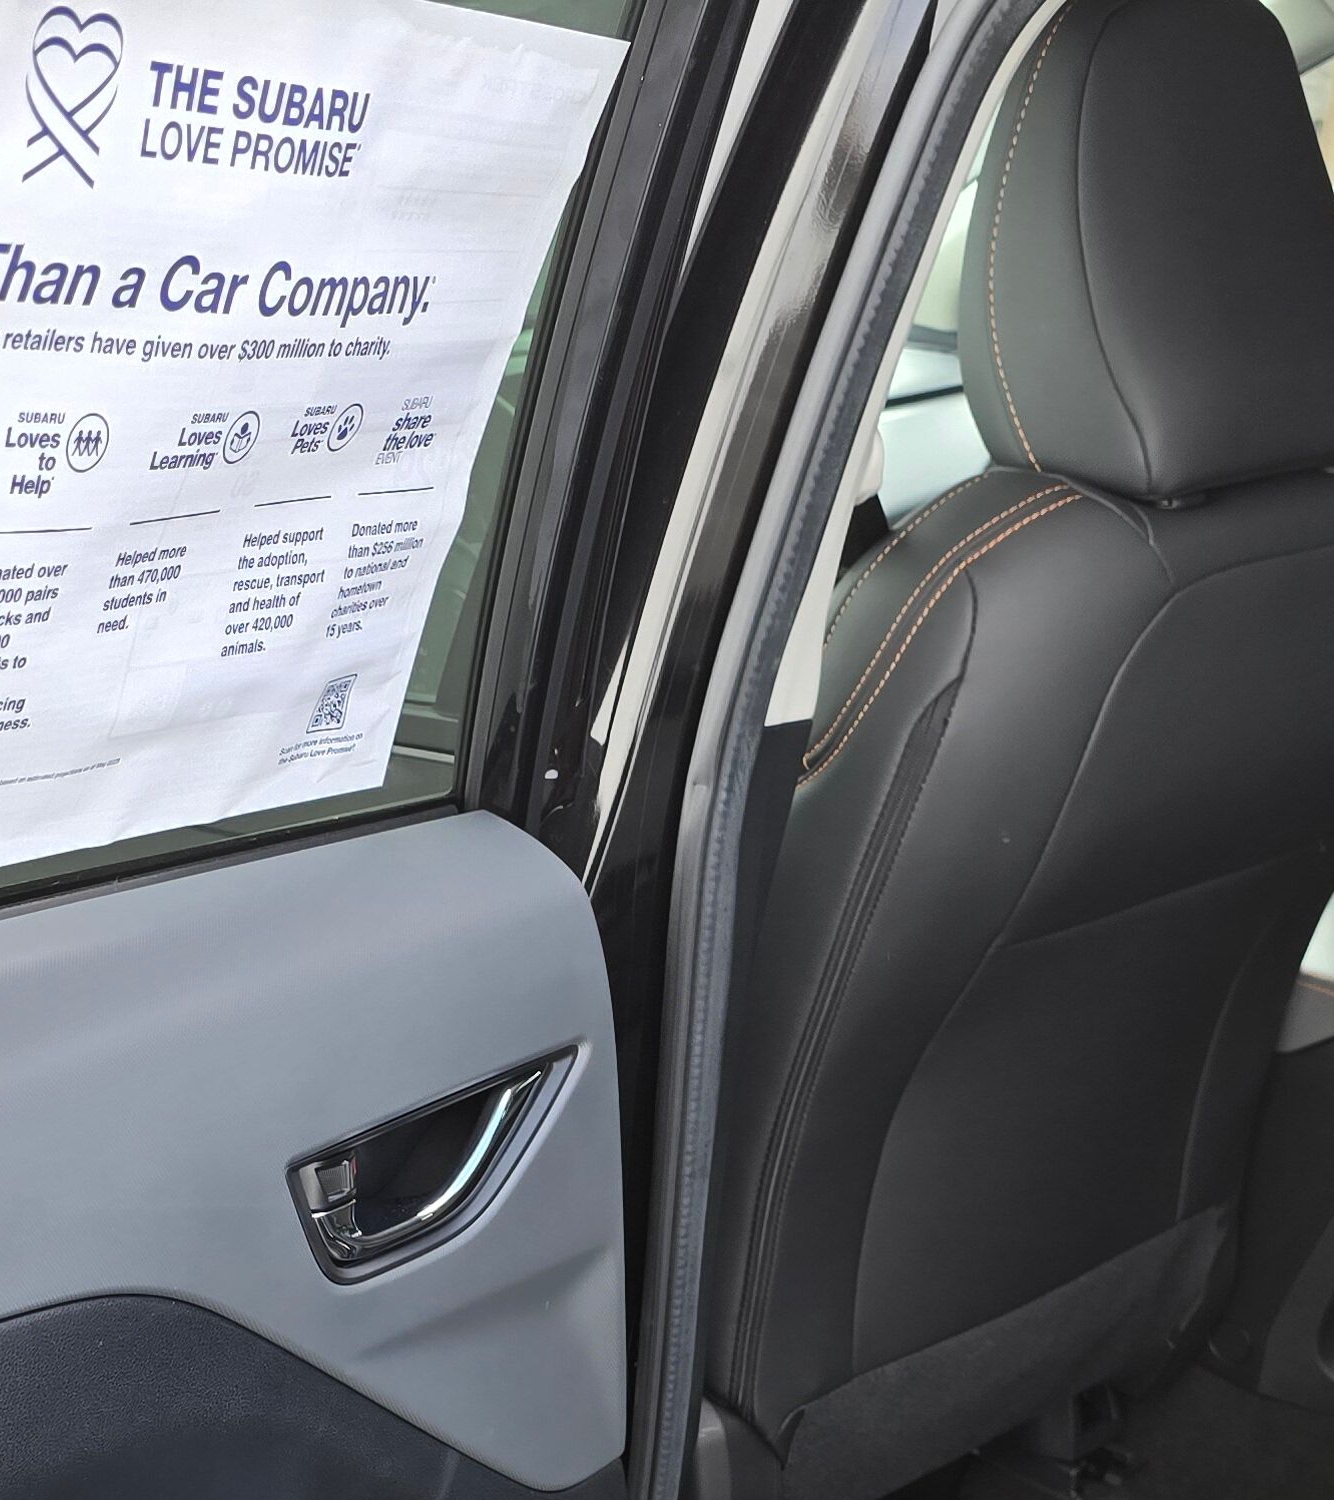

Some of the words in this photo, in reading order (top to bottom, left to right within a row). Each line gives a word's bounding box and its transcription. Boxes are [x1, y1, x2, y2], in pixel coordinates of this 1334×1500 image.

[150, 61, 224, 114] THE
[233, 76, 370, 136] SUBARU
[141, 119, 224, 164] LOVE
[230, 130, 357, 177] PROMISE
[112, 267, 146, 308] a
[160, 255, 249, 314] Car
[3, 329, 85, 352] retailers
[91, 332, 136, 355] have
[142, 335, 192, 362] given
[198, 344, 236, 360] over
[238, 340, 275, 361] $300
[276, 339, 325, 358] million
[328, 339, 342, 357] to
[345, 337, 390, 360] charity.
[18, 413, 65, 424] SUBARU
[191, 413, 229, 424] SUBARU
[305, 405, 337, 417] SUBARU
[291, 420, 329, 437] Loves
[392, 413, 431, 431] share
[5, 427, 60, 448] Loves
[178, 428, 222, 446] Loves
[39, 453, 56, 471] to
[150, 449, 215, 470] Learning
[10, 475, 51, 498] Help
[352, 520, 393, 537] Donated
[395, 521, 417, 533] more
[243, 530, 280, 549] Helped
[282, 528, 323, 546] support
[348, 545, 369, 558] than
[394, 538, 423, 552] million
[116, 548, 157, 567] Helped
[158, 546, 186, 560] more
[238, 556, 254, 569] the
[257, 551, 307, 569] adoption,
[38, 565, 68, 578] over
[109, 574, 134, 589] than
[137, 565, 181, 584] 470,000
[344, 567, 353, 579] to
[355, 559, 391, 577] national
[390, 556, 409, 570] and
[233, 578, 272, 591] rescue,
[277, 570, 324, 588] transport
[338, 581, 382, 599] hometown
[25, 586, 59, 605] pairs
[103, 592, 153, 611] students
[156, 589, 166, 602] in
[229, 598, 250, 613] and
[252, 594, 285, 610] health
[289, 592, 301, 606] of
[25, 607, 51, 624] and
[331, 601, 367, 618] charities
[369, 597, 389, 609] over
[97, 615, 128, 633] need.
[225, 623, 249, 635] over
[252, 614, 293, 632] 420,000
[326, 624, 336, 636] 15
[337, 621, 362, 638] years.
[221, 640, 265, 657] animals.
[13, 656, 26, 669] to
